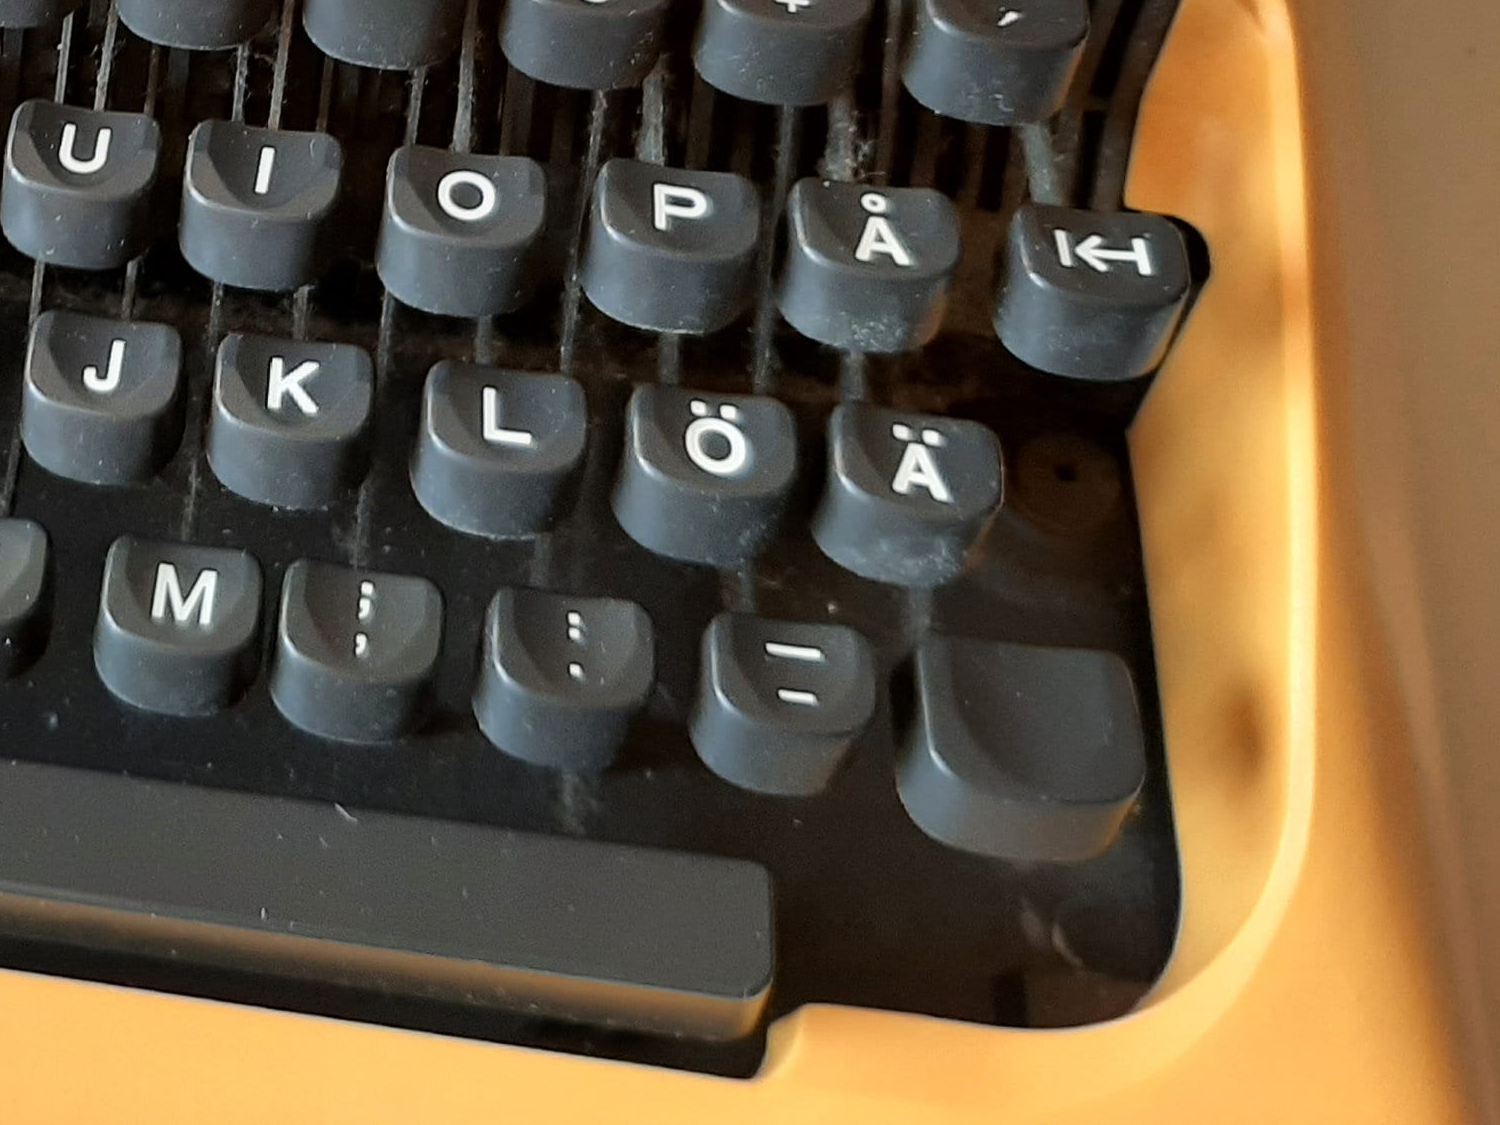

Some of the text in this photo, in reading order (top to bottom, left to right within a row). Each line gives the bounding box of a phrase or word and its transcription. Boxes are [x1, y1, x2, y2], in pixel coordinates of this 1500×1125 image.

[57, 123, 112, 175] U
[254, 146, 276, 195] I
[437, 170, 498, 222] O
[652, 182, 711, 231] P
[854, 192, 915, 267] Å
[82, 339, 127, 394] J
[266, 356, 322, 418] K
[482, 386, 536, 448] L
[684, 399, 752, 477] Ö
[891, 423, 954, 503] Ä
[150, 562, 219, 631] M
